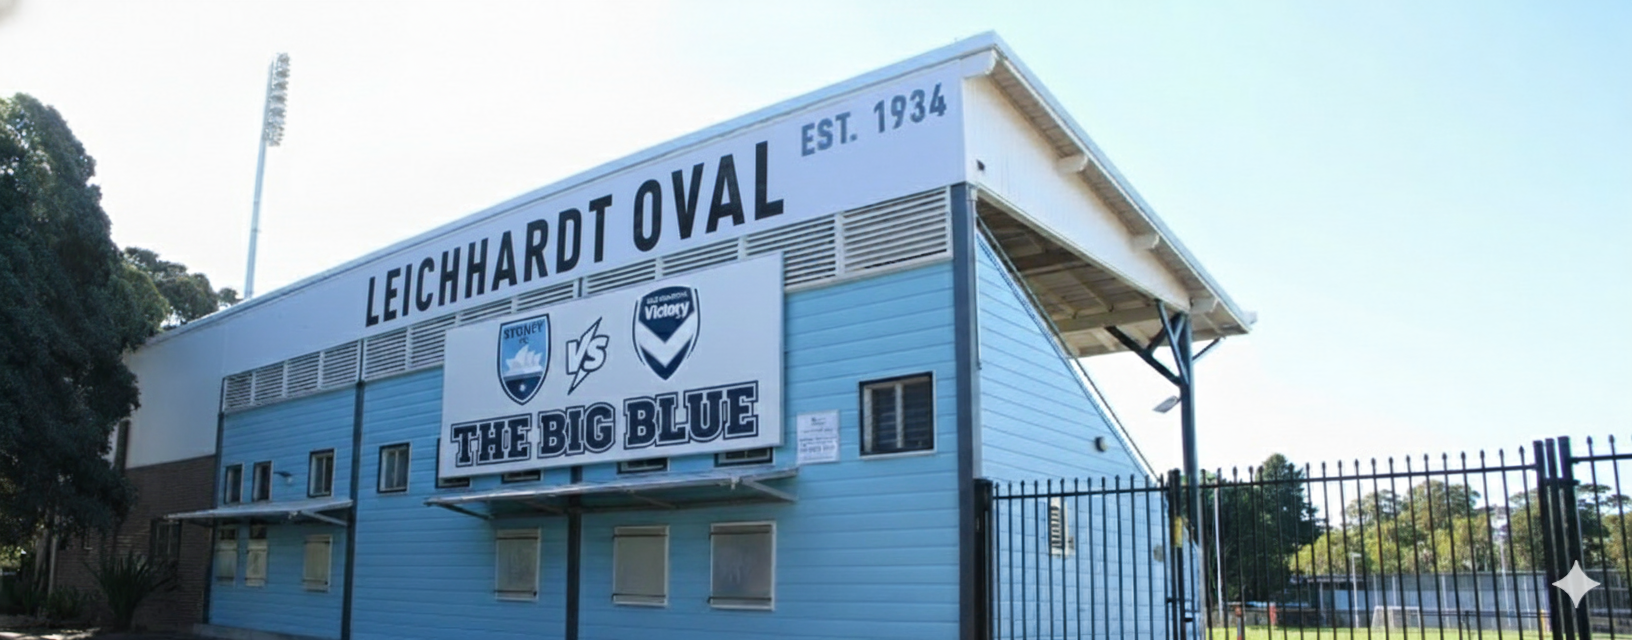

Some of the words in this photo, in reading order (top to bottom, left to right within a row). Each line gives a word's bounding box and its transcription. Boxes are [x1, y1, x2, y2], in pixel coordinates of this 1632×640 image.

[801, 111, 858, 157] EST.
[873, 82, 947, 133] 1934
[365, 194, 613, 327] LEICHHARDT
[633, 140, 784, 252] OVAL
[645, 301, 690, 320] Victory
[451, 413, 532, 467] THE
[537, 402, 616, 459] BIG
[624, 380, 759, 450] BLUE
